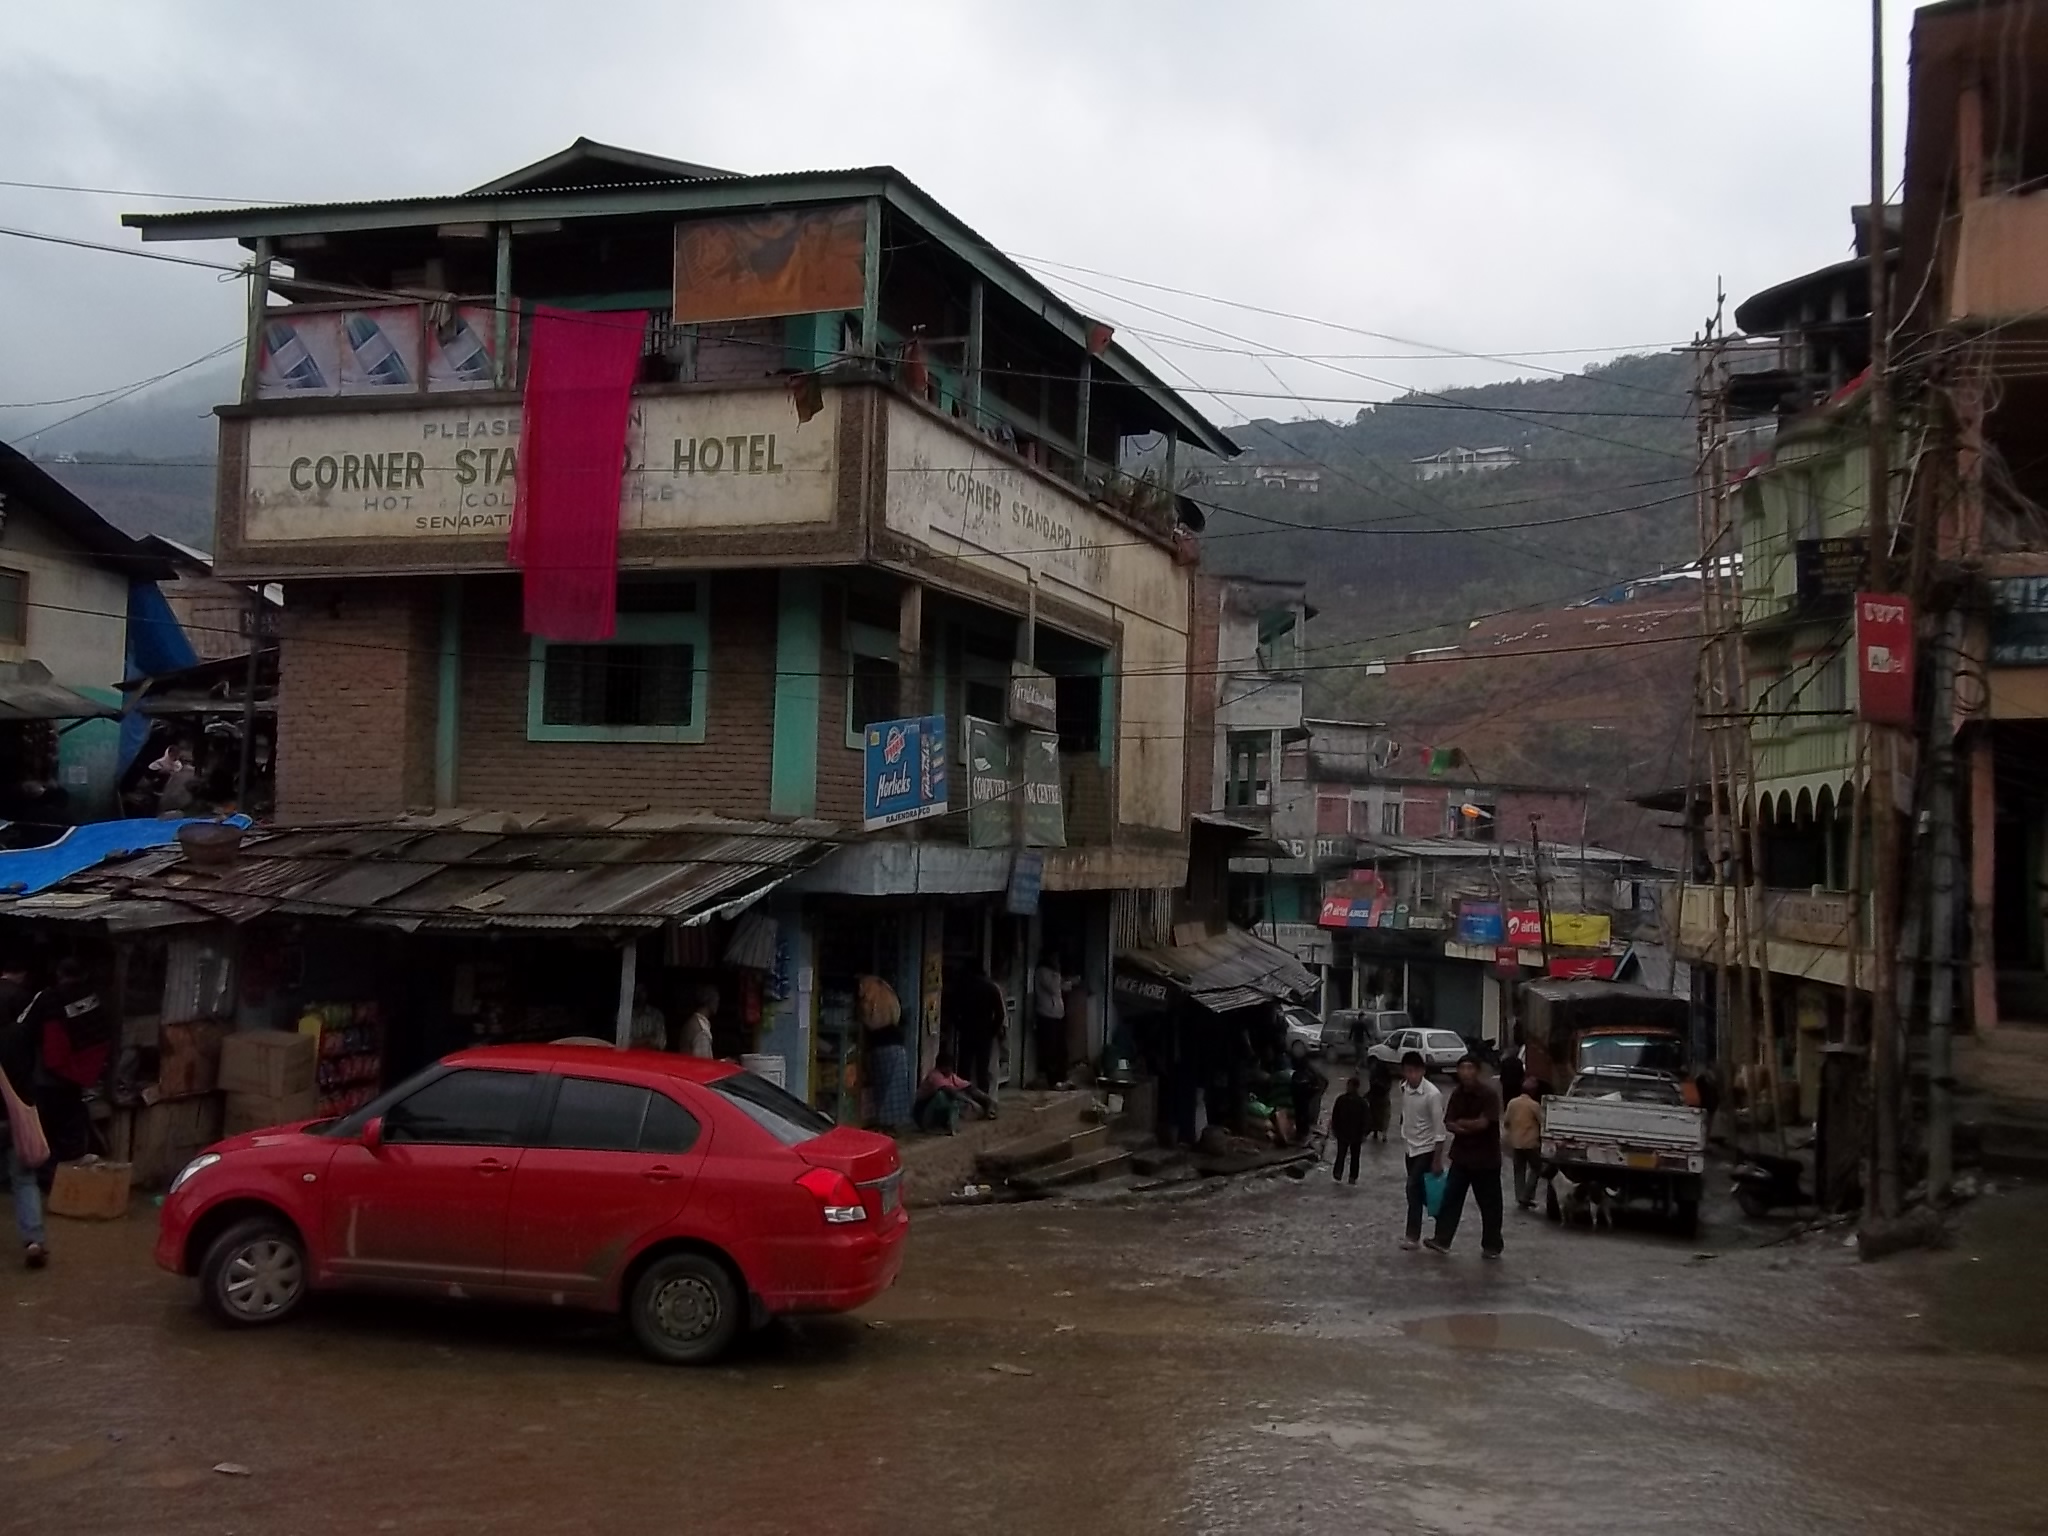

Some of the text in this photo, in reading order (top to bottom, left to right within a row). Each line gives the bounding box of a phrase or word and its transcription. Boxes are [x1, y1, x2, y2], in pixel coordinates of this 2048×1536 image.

[422, 418, 520, 439] PLEASE
[289, 451, 425, 492] CORNER
[673, 433, 784, 476] HOTEL
[363, 496, 414, 511] HOT
[464, 491, 514, 509] COL
[946, 468, 1002, 515] CORNER
[1011, 501, 1072, 549] STANDARD
[415, 514, 513, 530] SENAPATI
[875, 761, 912, 808] Horlicks
[1519, 917, 1541, 934] airtel
